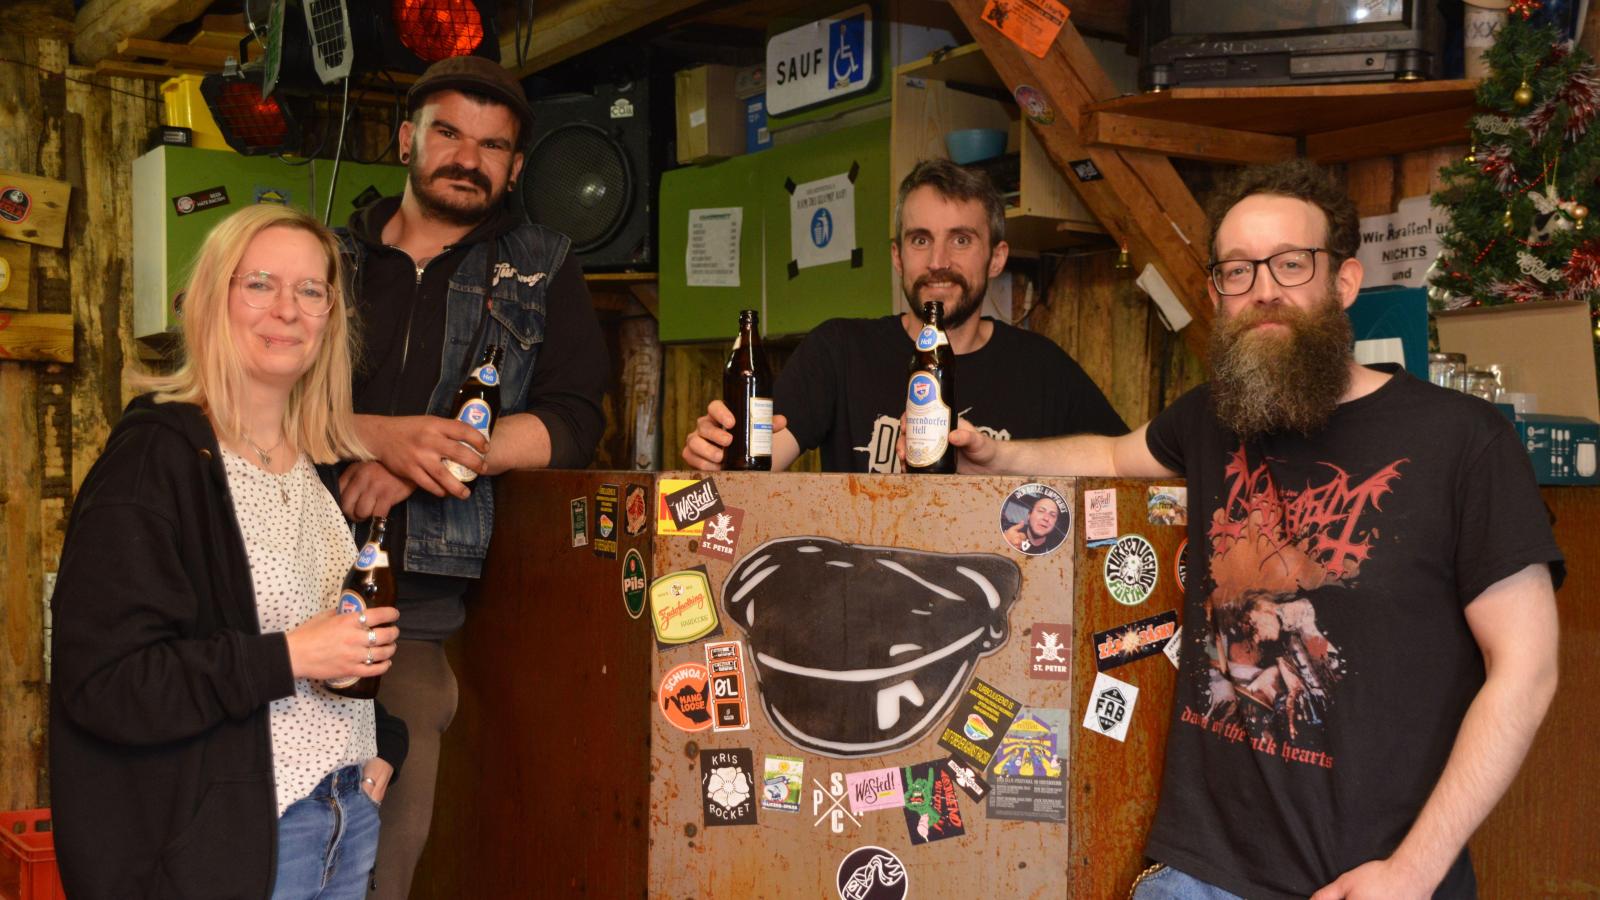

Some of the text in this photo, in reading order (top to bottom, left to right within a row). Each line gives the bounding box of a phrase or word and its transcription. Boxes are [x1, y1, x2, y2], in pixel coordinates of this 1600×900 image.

[776, 48, 823, 86] SAUF
[1362, 232, 1384, 244] Wir
[1382, 246, 1427, 262] NICHTS
[1392, 268, 1412, 280] und
[912, 426, 926, 434] Hell
[702, 541, 734, 554] ST. PETER
[624, 576, 644, 592] Pils
[714, 678, 738, 696] ØL
[680, 693, 702, 704] HANG
[681, 701, 705, 712] LOOSE
[1096, 698, 1125, 722] FAB
[1212, 719, 1224, 736] of
[1224, 723, 1246, 743] the
[1282, 740, 1334, 768] hearts
[712, 753, 738, 766] KRIS
[831, 772, 844, 796] S
[814, 790, 824, 816] P
[710, 803, 750, 820] ROCKET
[832, 810, 844, 834] C
